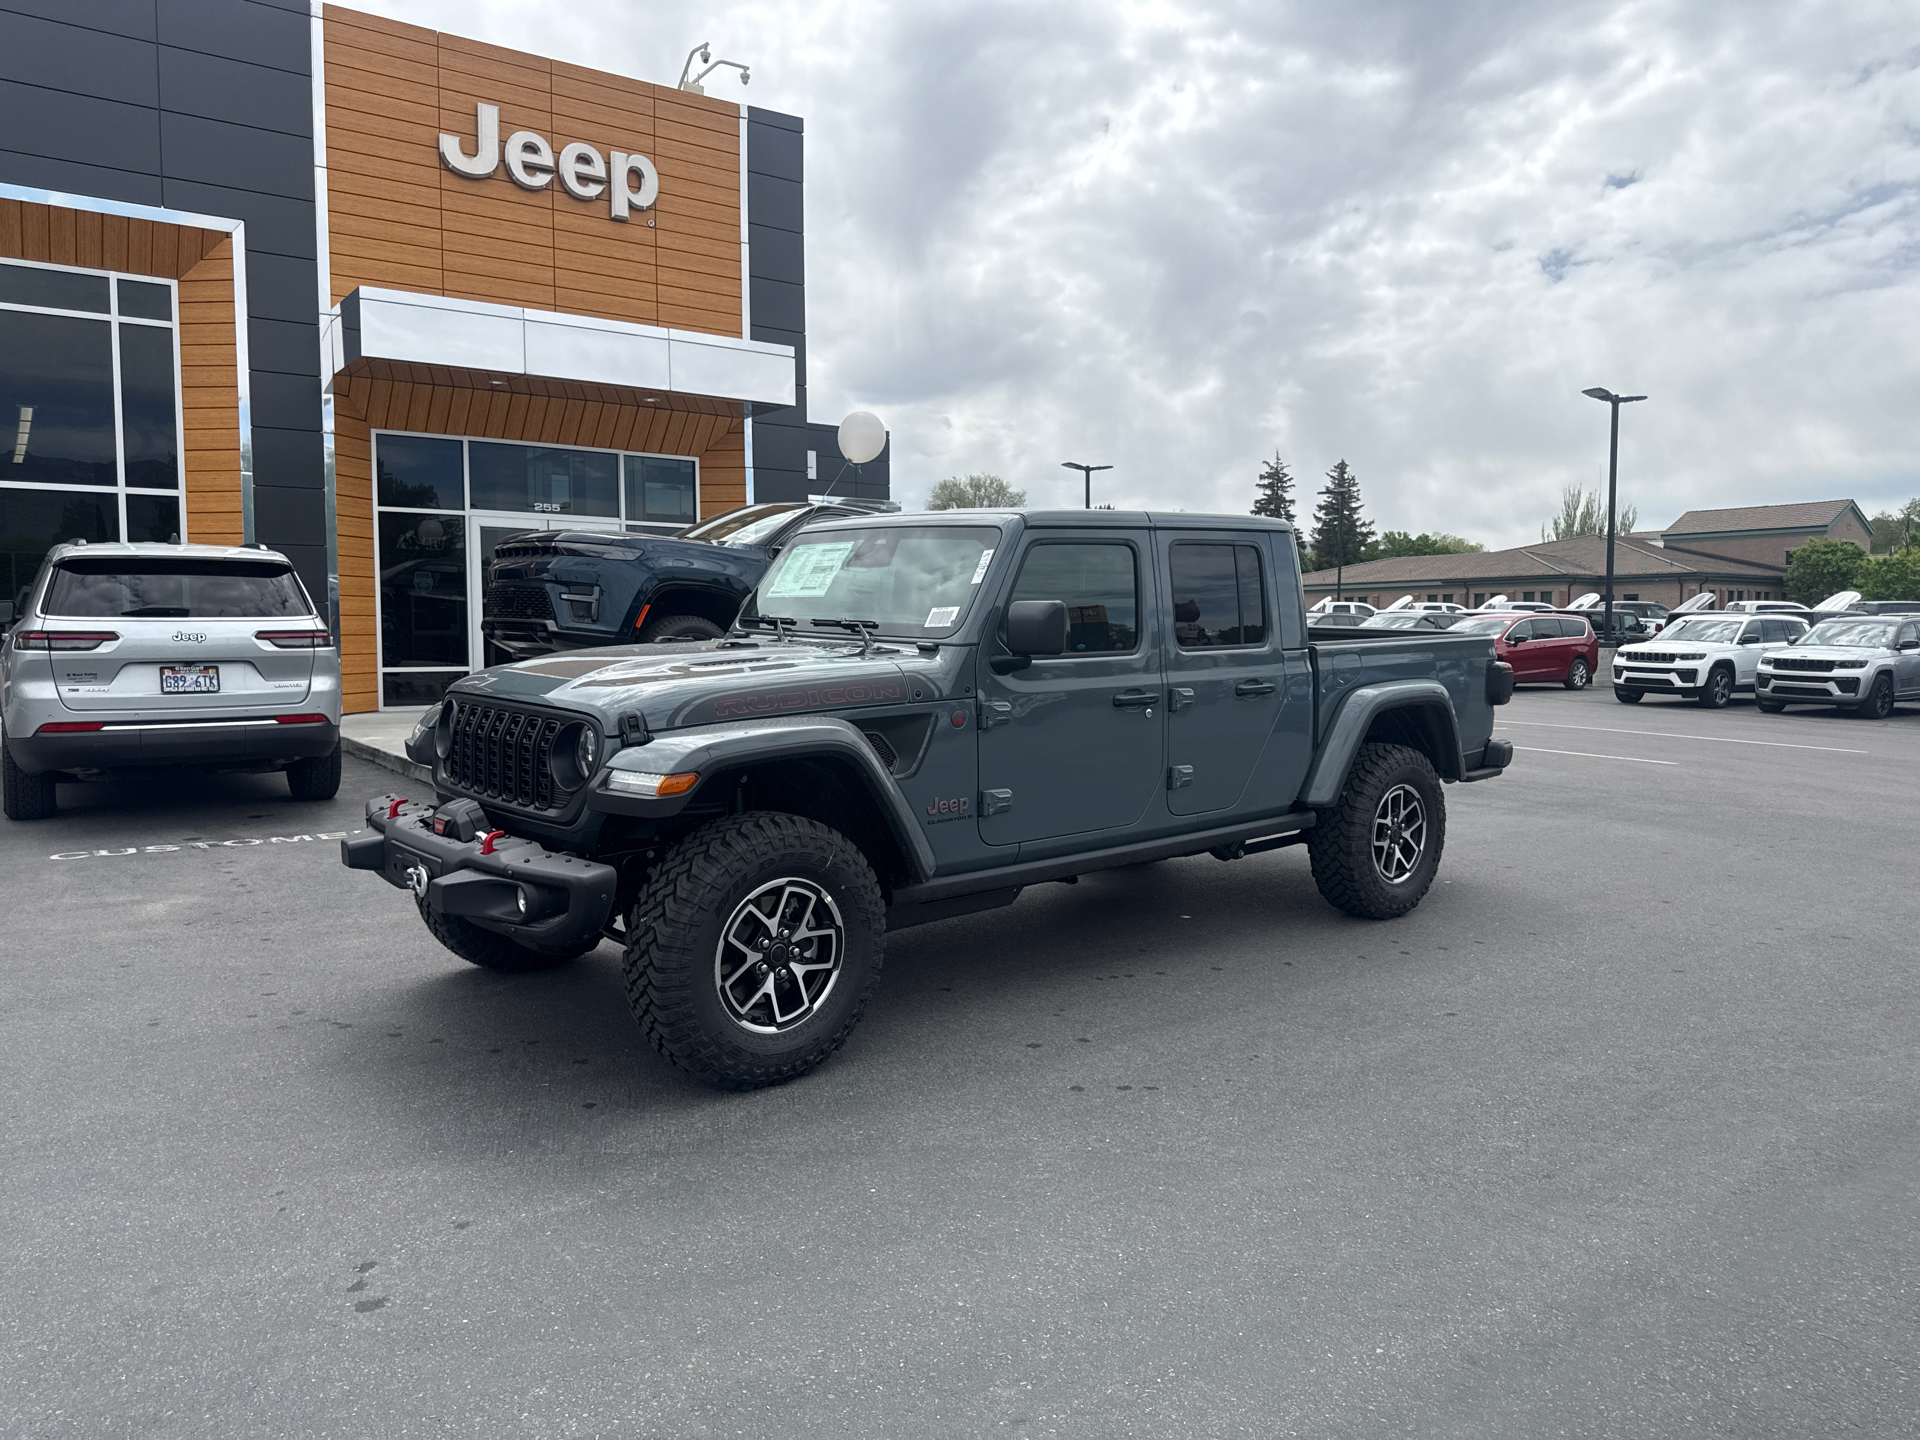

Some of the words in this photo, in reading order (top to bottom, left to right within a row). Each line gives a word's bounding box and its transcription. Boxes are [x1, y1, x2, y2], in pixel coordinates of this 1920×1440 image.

[439, 102, 659, 222] Jeep
[533, 502, 561, 512] 255
[172, 631, 207, 643] Jeep
[165, 675, 187, 688] G89
[195, 675, 216, 688] 6TK
[714, 683, 900, 716] RUBICON
[927, 797, 969, 815] Jeep
[927, 816, 966, 825] GLADIATOR
[50, 830, 362, 860] CUSTOME
